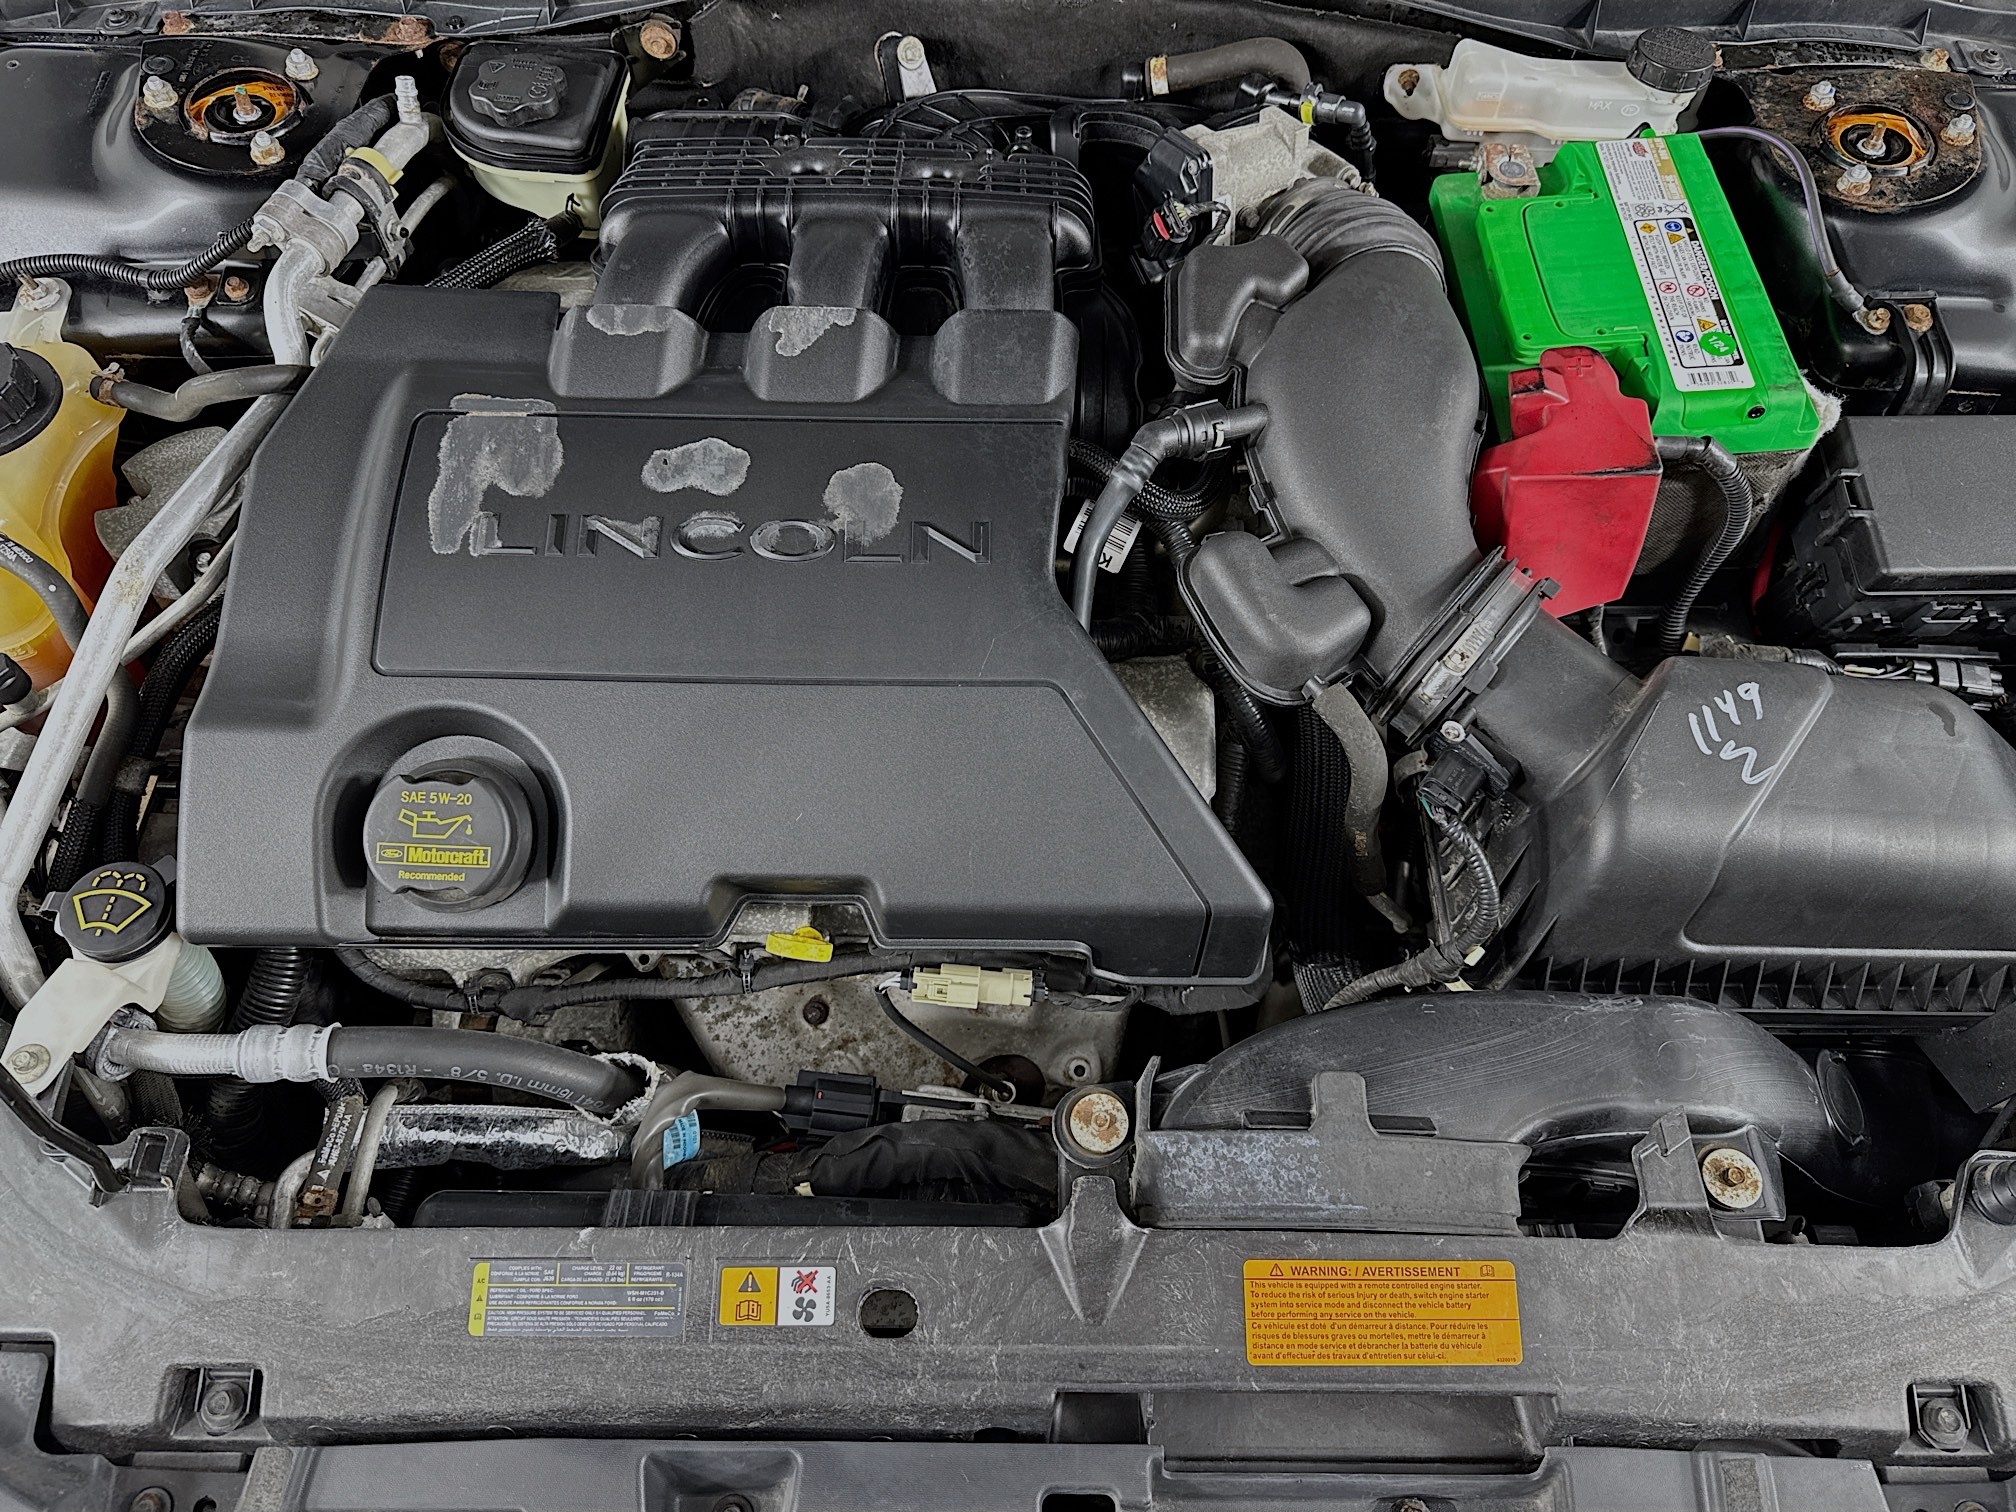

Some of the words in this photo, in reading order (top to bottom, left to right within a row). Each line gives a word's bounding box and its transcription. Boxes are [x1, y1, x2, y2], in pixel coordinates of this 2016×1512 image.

[1588, 101, 1612, 110] MAX
[1691, 240, 1720, 300] DANGER/POISON
[1708, 335, 1729, 352] 1/24
[471, 511, 991, 565] LINCOLN
[1688, 682, 1763, 755] 1149
[401, 791, 426, 803] SAE
[430, 792, 472, 805] 5W-20
[398, 870, 465, 881] Recommended
[362, 1064, 417, 1075] R134a
[497, 1071, 522, 1086] I.D.
[528, 1079, 574, 1099] 16mm
[317, 1132, 336, 1166] FoMoCo
[1290, 1266, 1351, 1276] WARNING:
[1355, 1266, 1359, 1276] /
[1362, 1266, 1460, 1277] AVERTISSEMENT
[1250, 1281, 1266, 1289] This
[1267, 1281, 1294, 1289] vehicle
[1296, 1281, 1303, 1289] is
[1305, 1281, 1338, 1290] equipped
[1340, 1281, 1356, 1289] with
[1430, 1283, 1455, 1291] engine
[1389, 1292, 1412, 1300] death,
[1440, 1292, 1464, 1300] engine
[1446, 1302, 1471, 1310] battery
[1277, 1311, 1318, 1320] performing
[1349, 1322, 1387, 1330] démarreur
[1252, 1333, 1279, 1341] risques
[1282, 1332, 1291, 1340] de
[1293, 1332, 1329, 1340] blessures
[1370, 1332, 1406, 1340] mortelles,
[1433, 1332, 1440, 1340] le
[1441, 1332, 1479, 1340] démarreur
